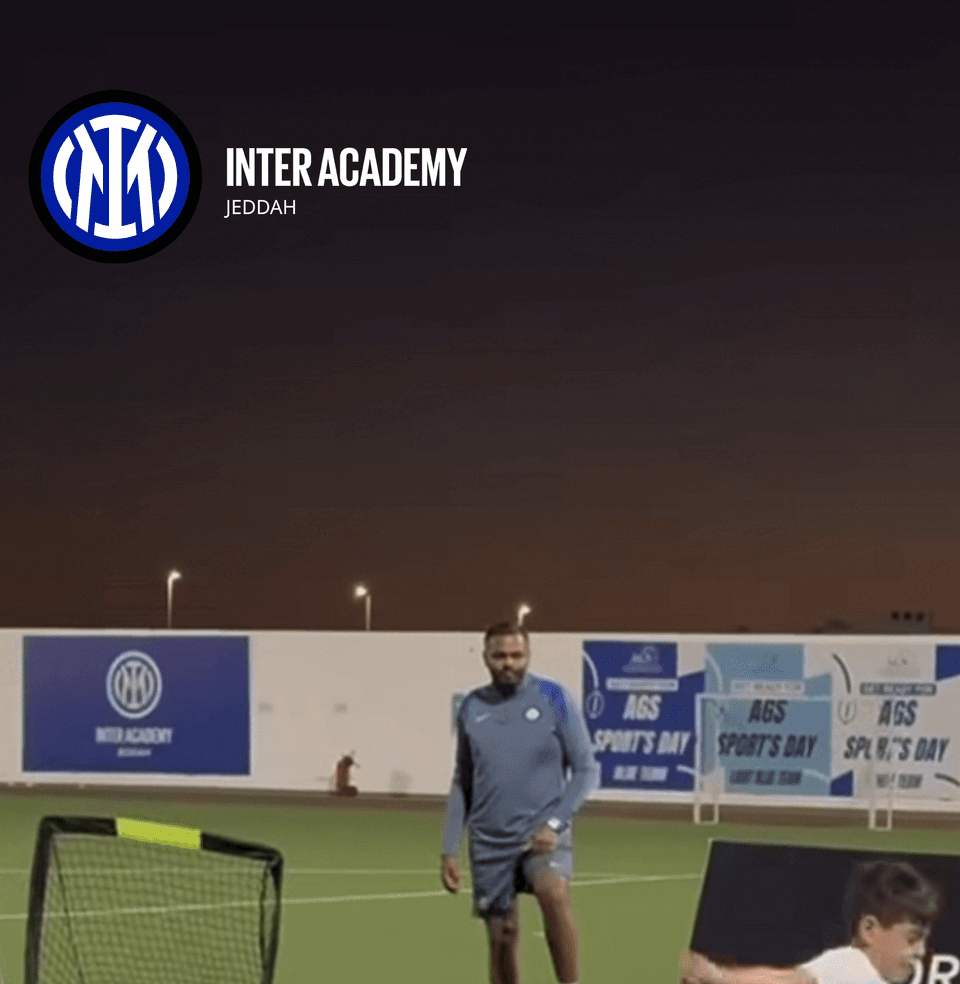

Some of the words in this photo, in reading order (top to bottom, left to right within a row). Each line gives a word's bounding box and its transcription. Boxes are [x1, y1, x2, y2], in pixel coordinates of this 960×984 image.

[623, 694, 662, 721] AGS
[748, 699, 788, 724] AGS
[878, 699, 918, 726] AGS
[656, 730, 691, 755] DAY
[783, 733, 818, 758] DAY
[914, 737, 950, 762] DAY
